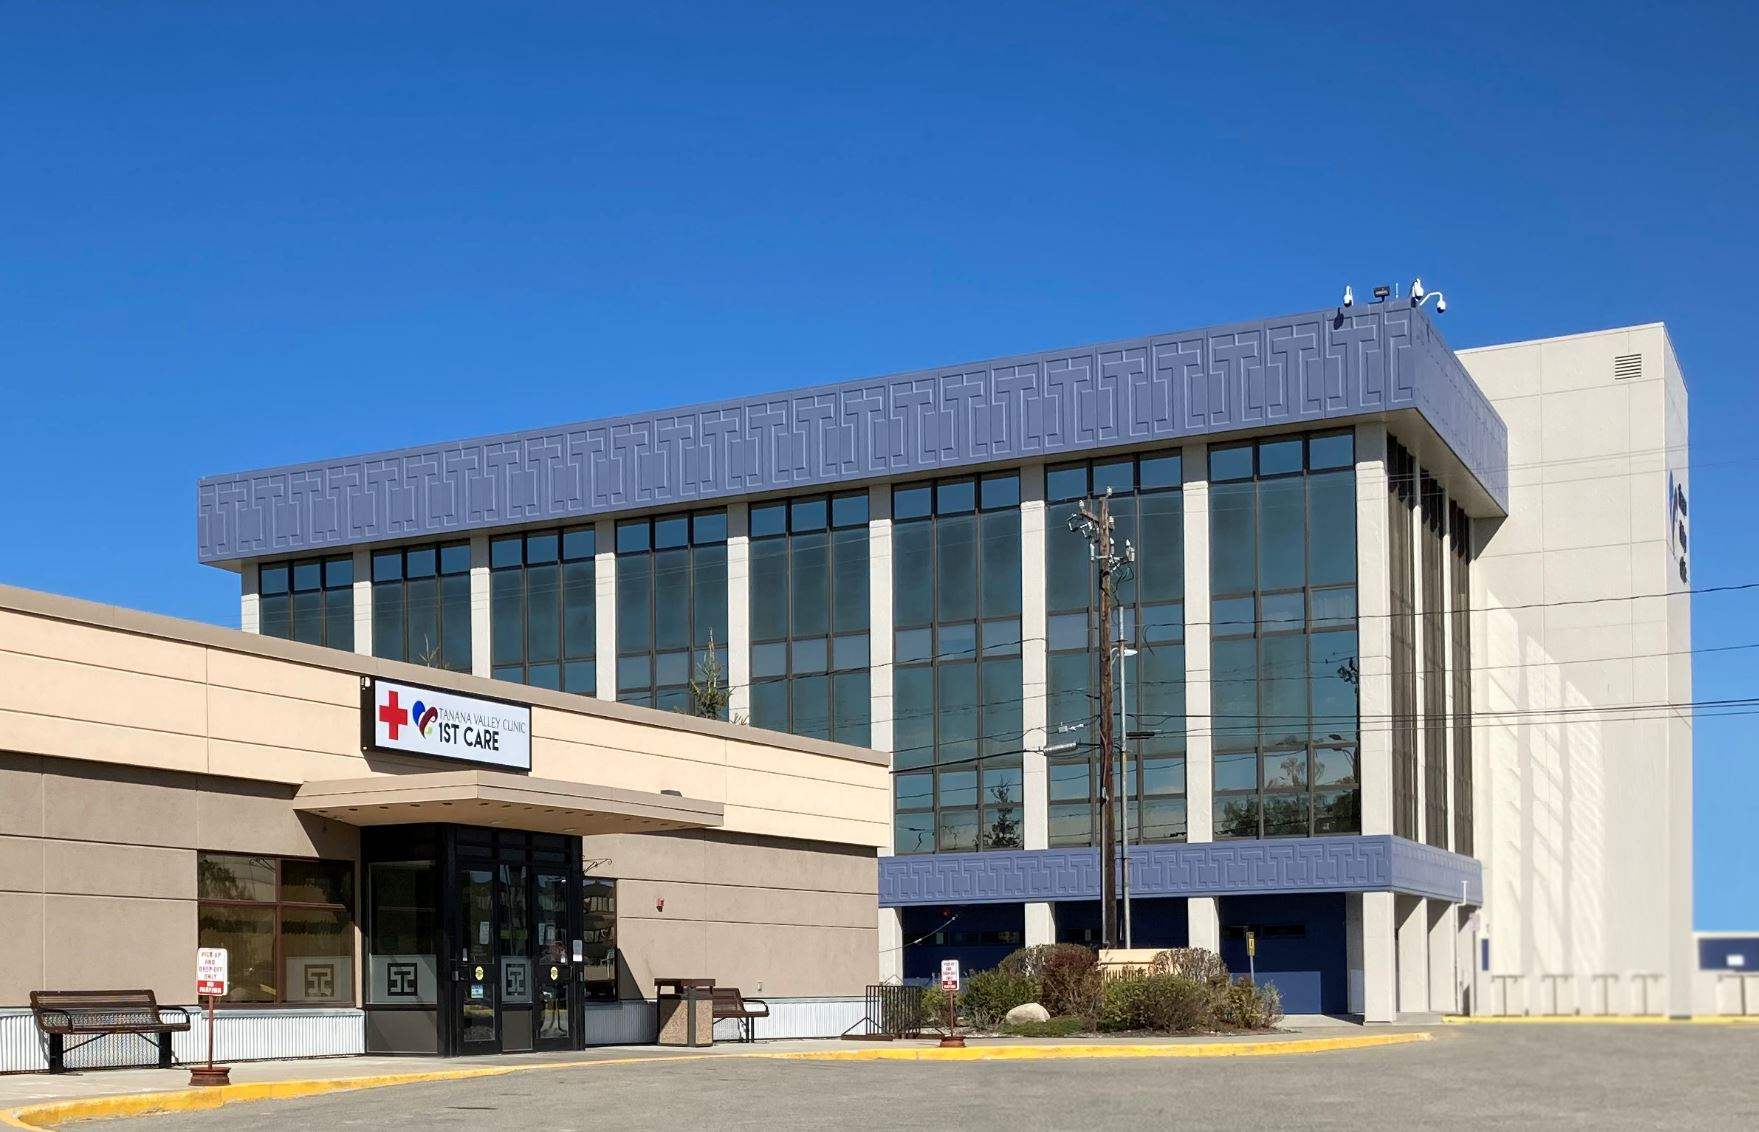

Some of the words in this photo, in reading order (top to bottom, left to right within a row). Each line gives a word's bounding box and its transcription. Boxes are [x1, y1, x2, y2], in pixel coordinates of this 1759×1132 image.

[439, 708, 472, 725] TANANA
[473, 713, 501, 729] VALLEY
[502, 719, 527, 735] CLINIC
[439, 722, 460, 745] 1ST
[464, 726, 500, 752] CARE
